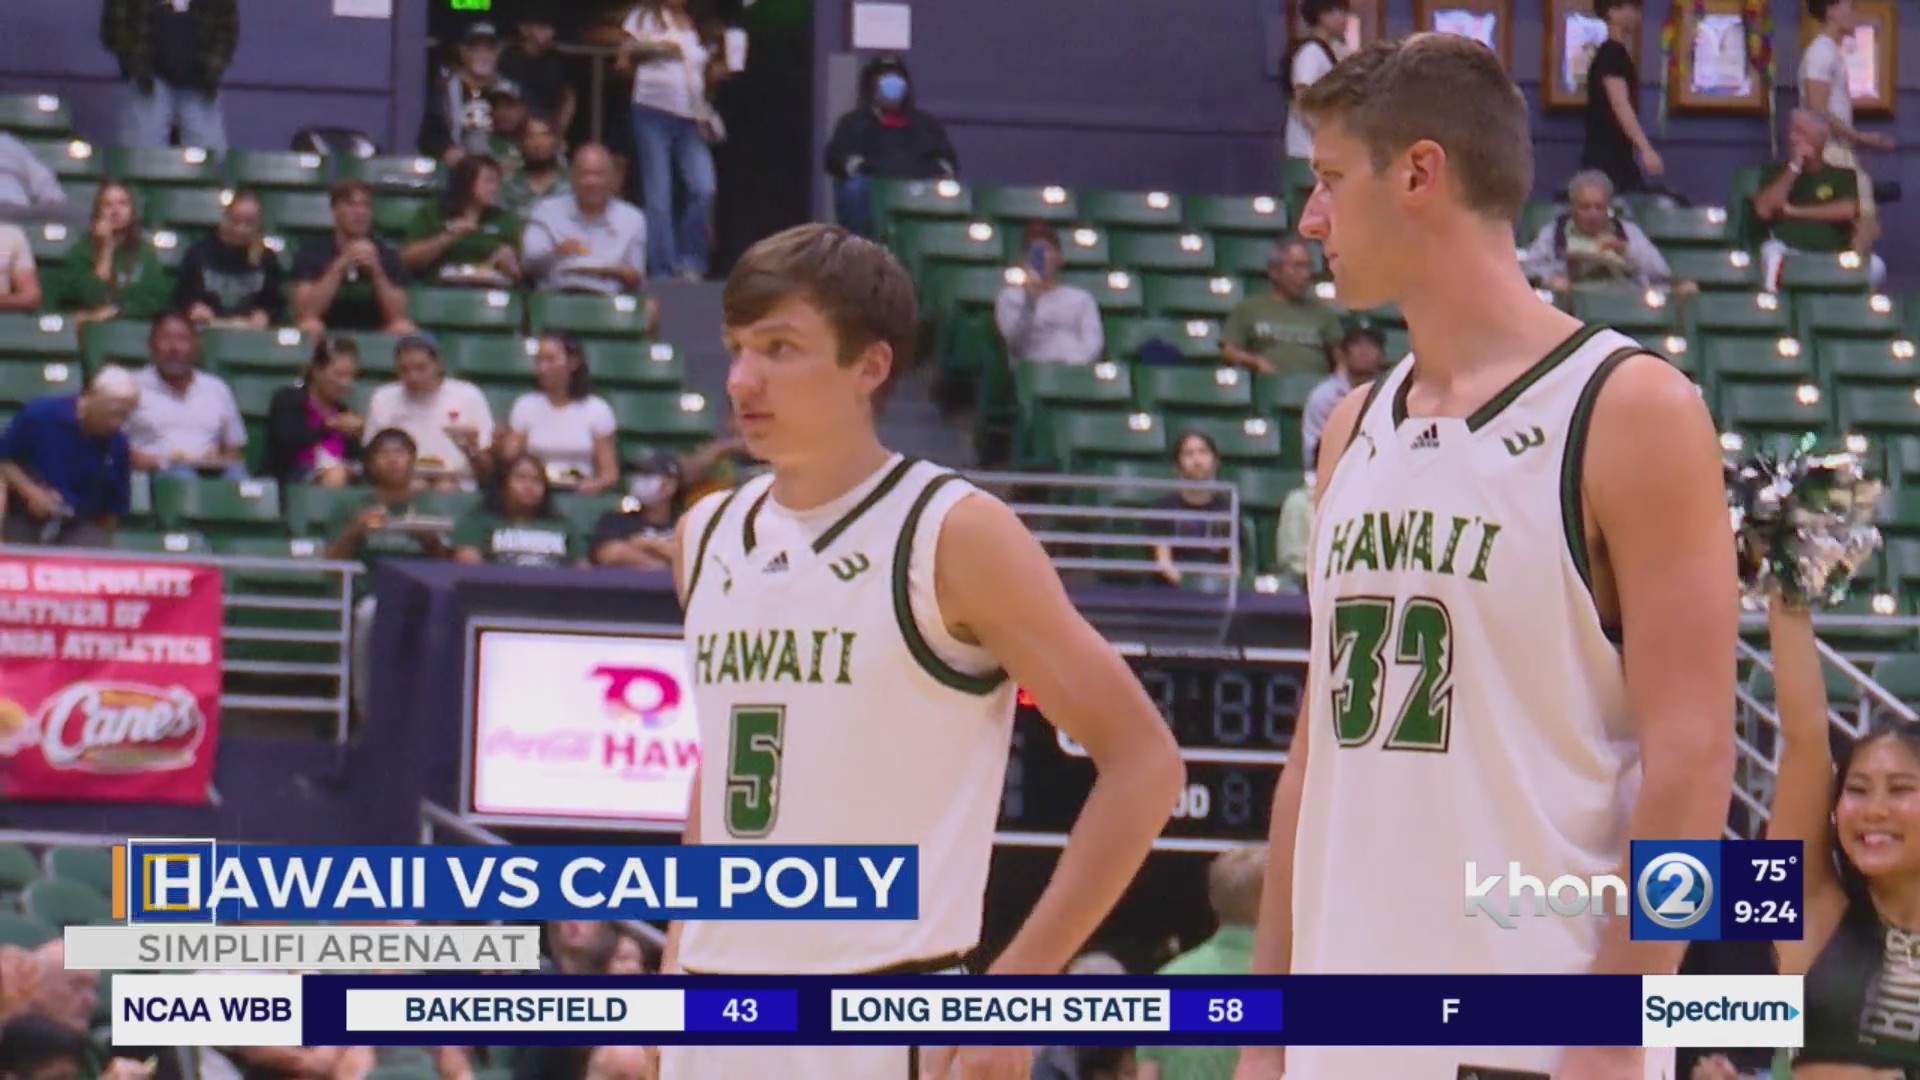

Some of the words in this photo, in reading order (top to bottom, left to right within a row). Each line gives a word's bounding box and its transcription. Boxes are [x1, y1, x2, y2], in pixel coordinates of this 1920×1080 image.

[42, 682, 200, 765] Cane's
[1330, 595, 1453, 752] 32
[724, 703, 787, 839] 5
